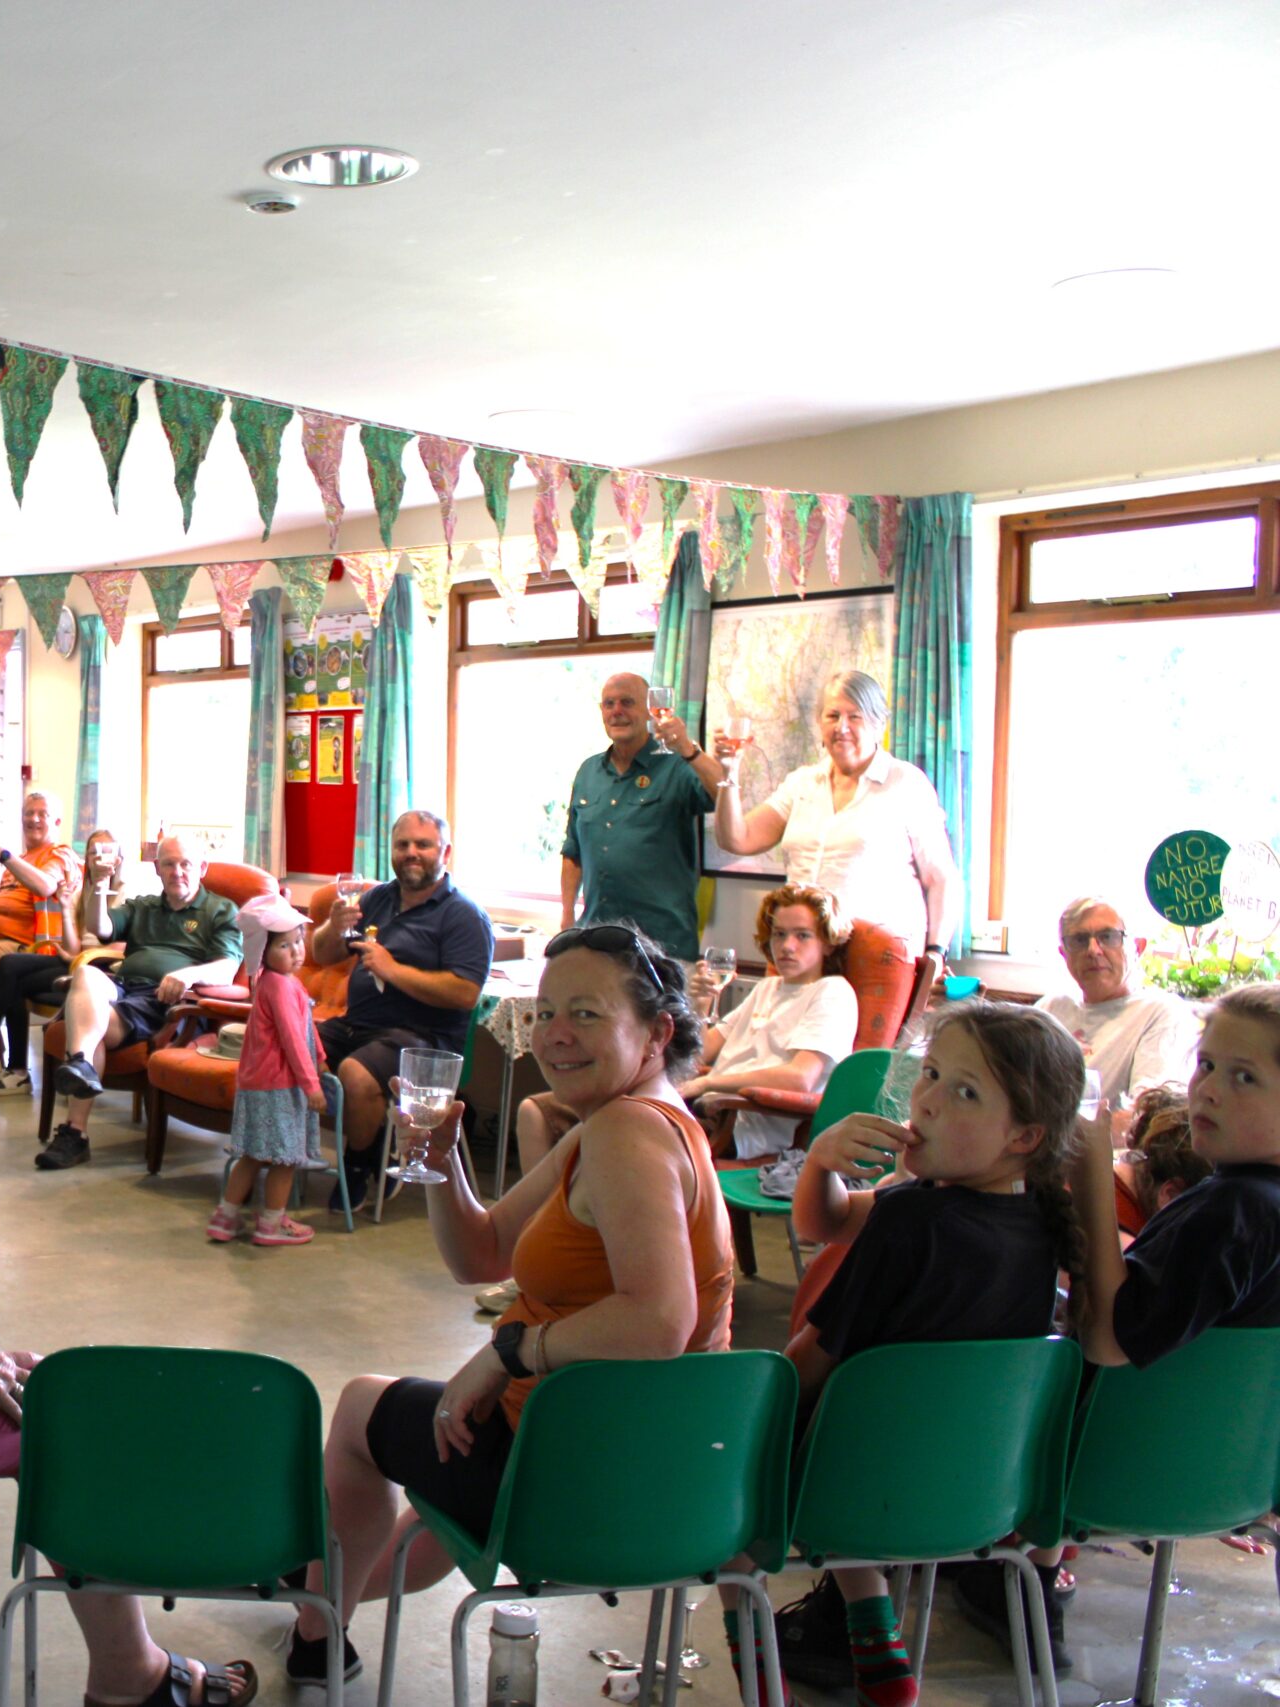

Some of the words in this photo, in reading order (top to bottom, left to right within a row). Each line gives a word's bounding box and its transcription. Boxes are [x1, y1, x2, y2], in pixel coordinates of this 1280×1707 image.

[1164, 836, 1207, 867] NO
[1155, 854, 1222, 890] NATURE
[1174, 879, 1207, 903] NO
[1222, 886, 1261, 913] PLANET
[1267, 900, 1277, 920] B
[1164, 894, 1223, 921] FUTUR
